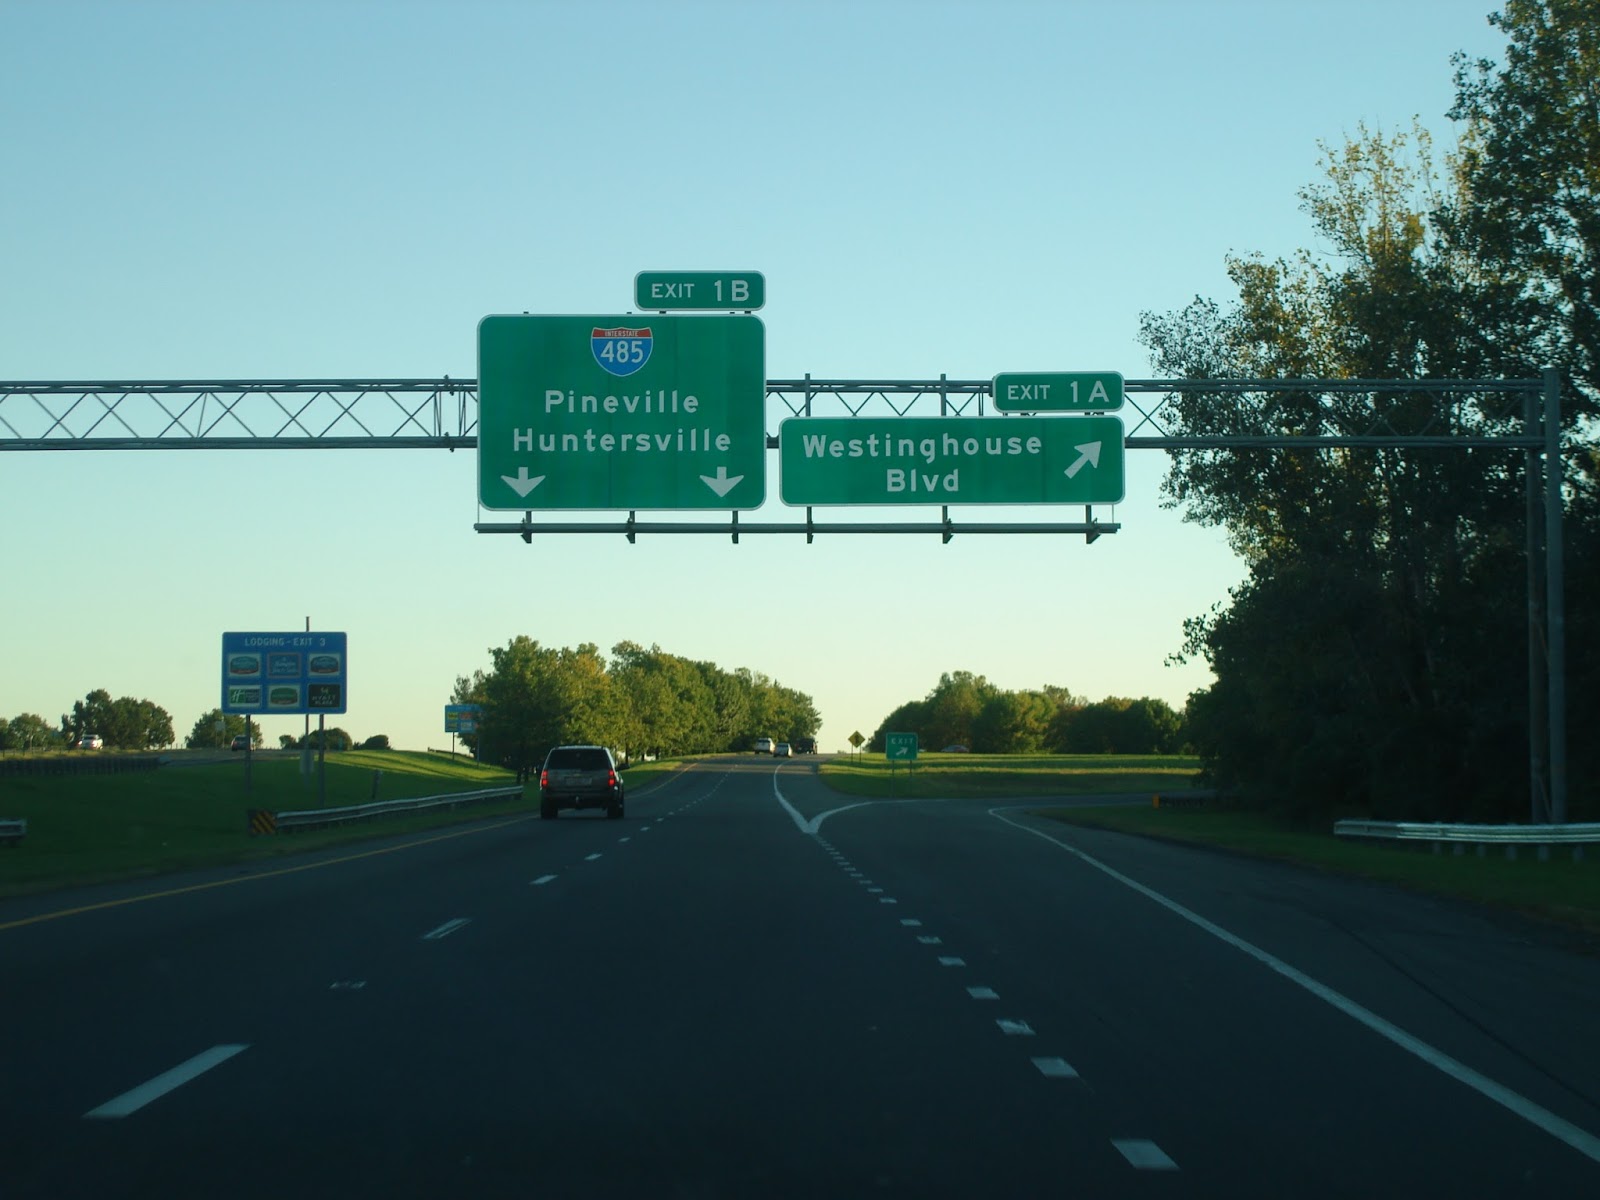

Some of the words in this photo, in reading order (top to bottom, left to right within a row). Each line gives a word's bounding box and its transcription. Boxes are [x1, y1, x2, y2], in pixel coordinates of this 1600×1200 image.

[652, 283, 694, 299] EXIT
[600, 340, 644, 363] 485
[545, 390, 699, 413] Pineville
[1007, 385, 1050, 400] EXIT
[513, 428, 731, 452] Huntersville
[803, 432, 1042, 463] Westinghouse
[886, 469, 959, 492] Blvd
[320, 638, 326, 647] 3
[891, 737, 914, 745] EXIT
